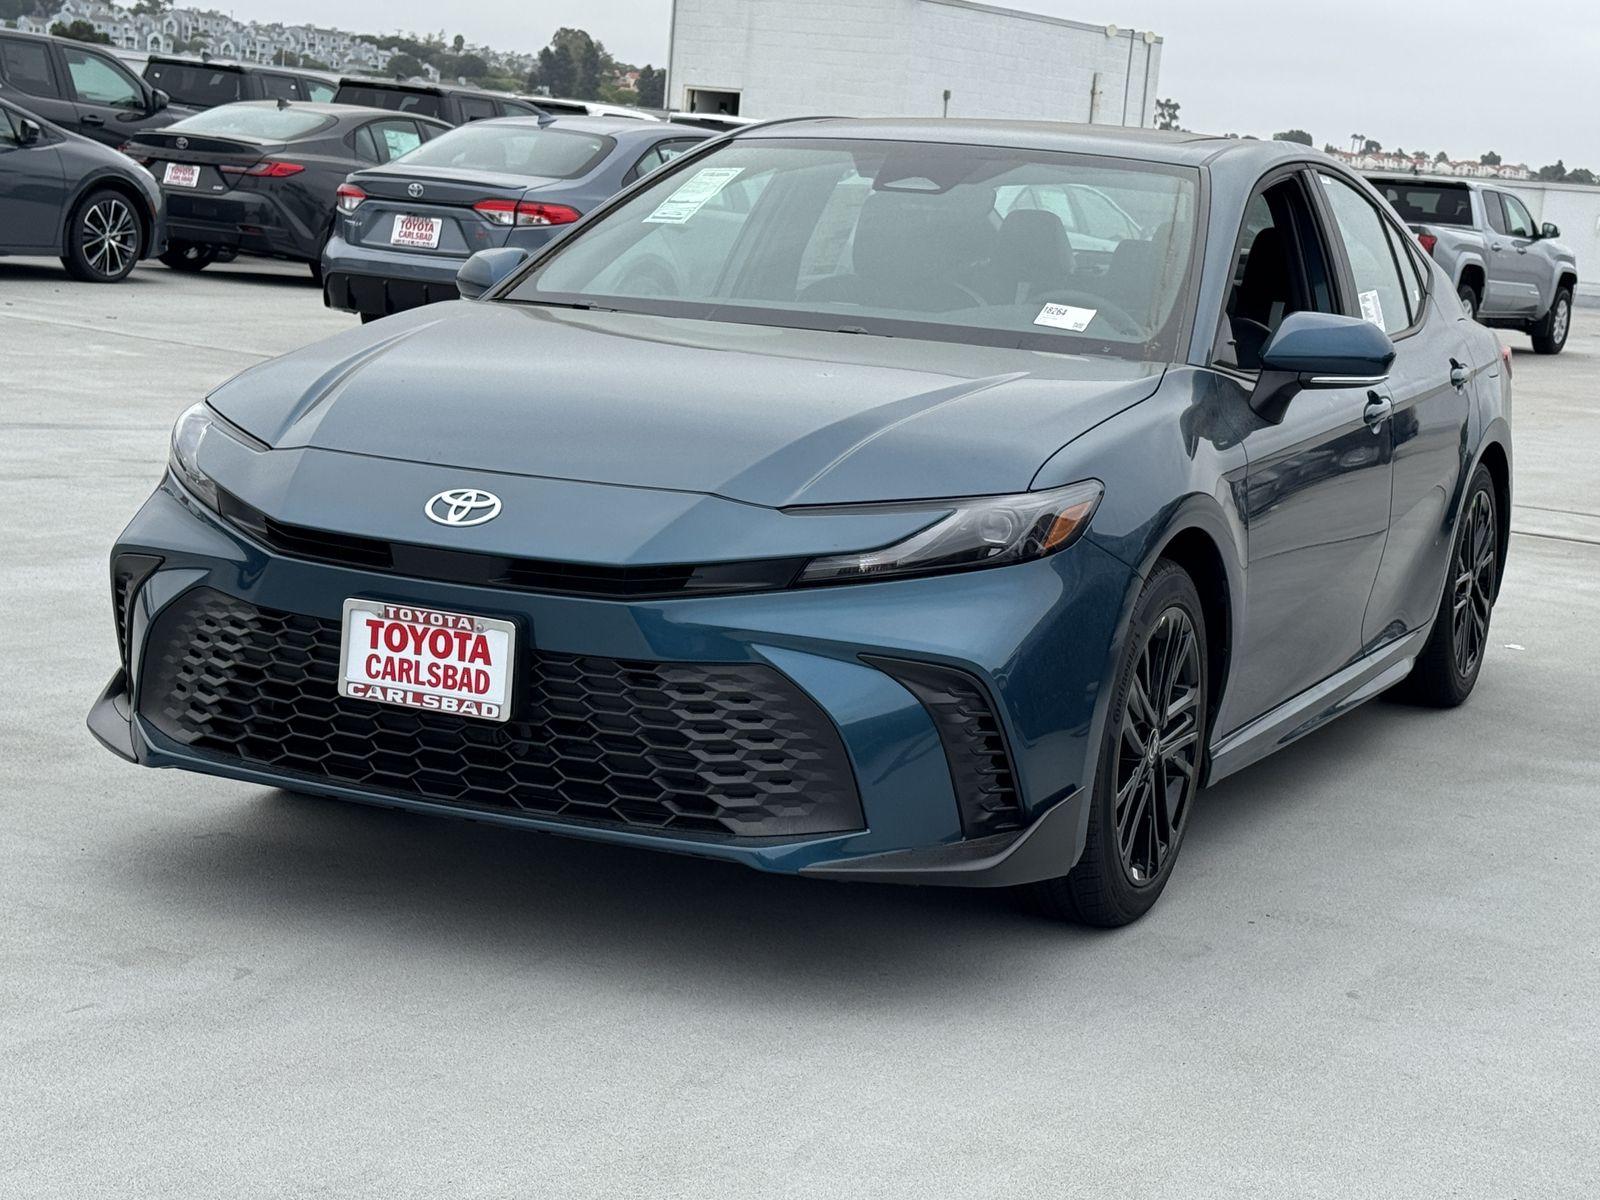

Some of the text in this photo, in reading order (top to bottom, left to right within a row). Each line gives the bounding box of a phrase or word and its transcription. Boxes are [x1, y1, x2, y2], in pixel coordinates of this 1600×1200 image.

[398, 230, 433, 242] CARLSBAD
[401, 220, 434, 233] TOYOTA
[1044, 306, 1068, 316] 18264
[386, 606, 473, 631] TOYOTA
[366, 618, 492, 667] TOYOTA
[365, 653, 491, 696] CARLSBAD
[1113, 640, 1140, 725] Continental
[347, 682, 500, 719] CARLSBAD
